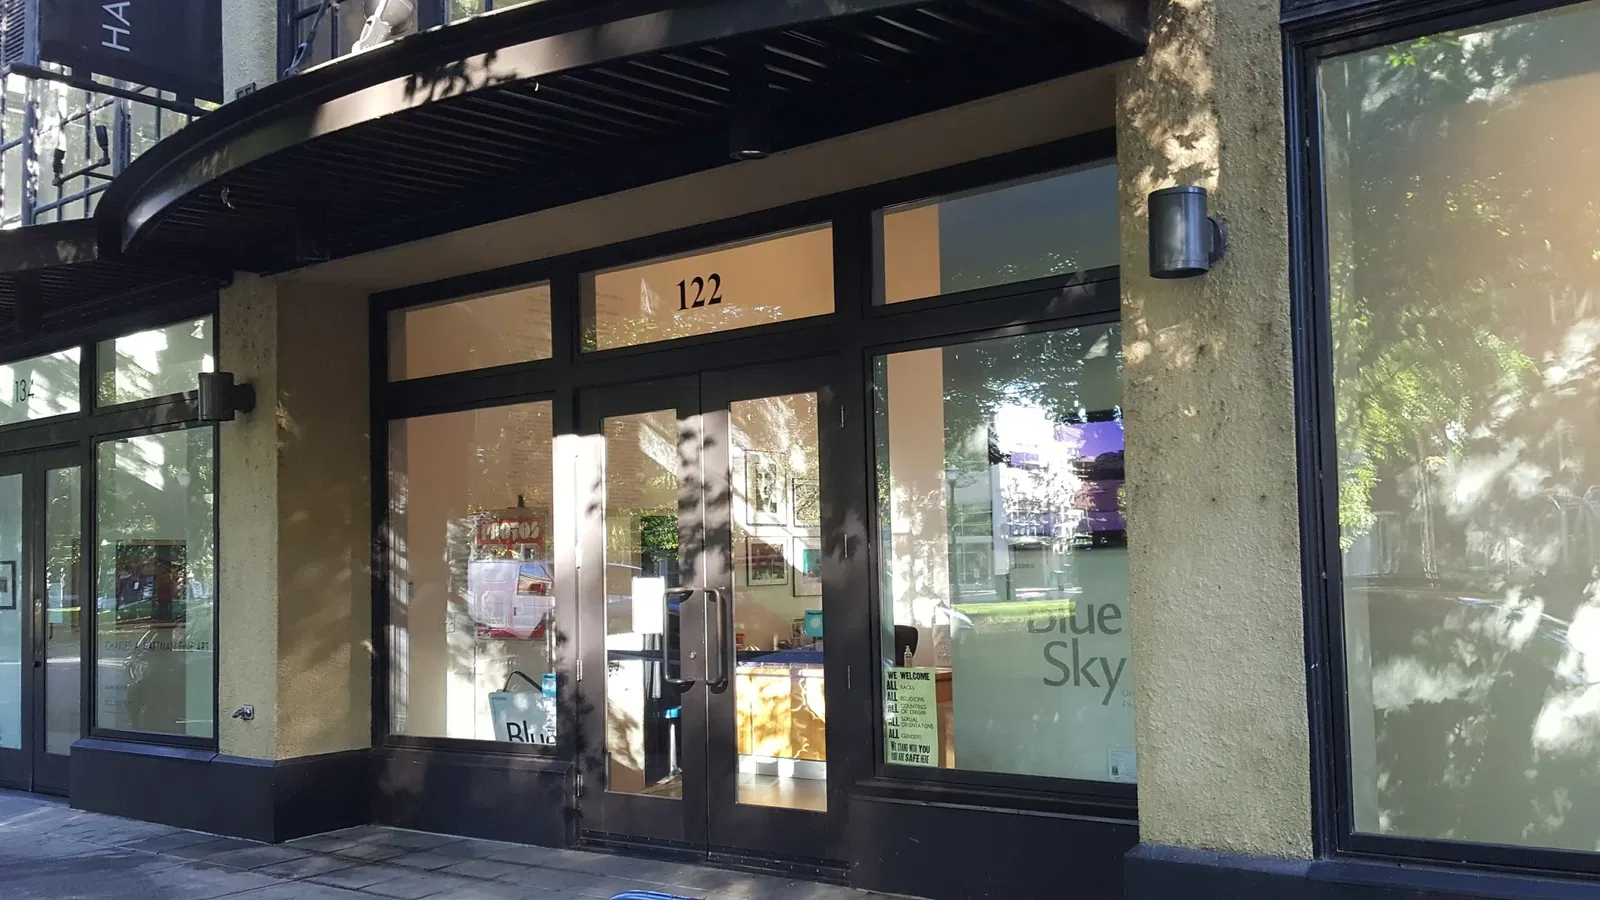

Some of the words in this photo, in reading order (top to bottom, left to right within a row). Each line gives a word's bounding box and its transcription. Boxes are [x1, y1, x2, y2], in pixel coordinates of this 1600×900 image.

[676, 273, 722, 311] 122
[887, 671, 898, 680] WE
[900, 671, 930, 680] WELCOME
[1043, 638, 1128, 706] Sky
[886, 680, 899, 691] ALL
[887, 691, 898, 702] ALL
[888, 728, 900, 739] ALL
[919, 744, 931, 754] YOU
[905, 753, 920, 763] SAFE
